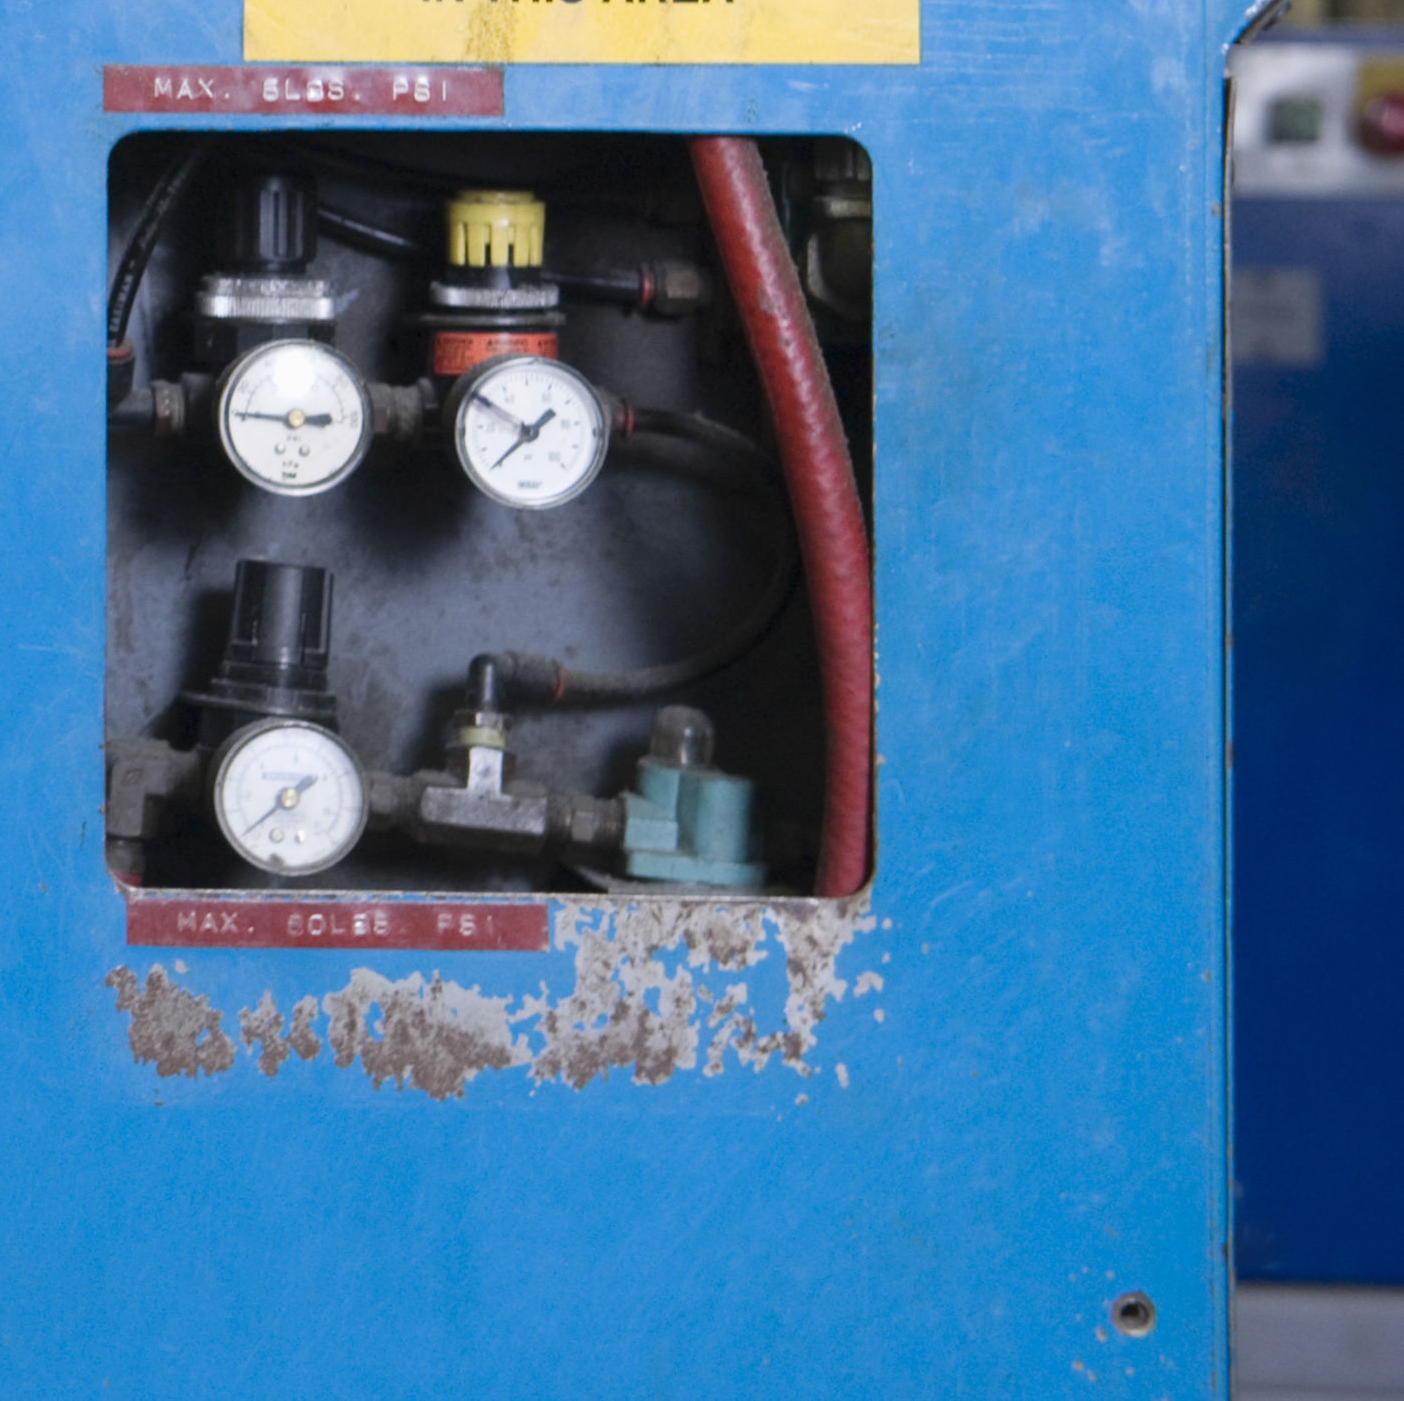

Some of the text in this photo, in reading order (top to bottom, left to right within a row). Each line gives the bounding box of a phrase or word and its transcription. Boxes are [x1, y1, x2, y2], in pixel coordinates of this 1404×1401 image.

[154, 77, 230, 100] MAX.
[393, 75, 448, 102] PSI
[176, 910, 254, 934] MAX.
